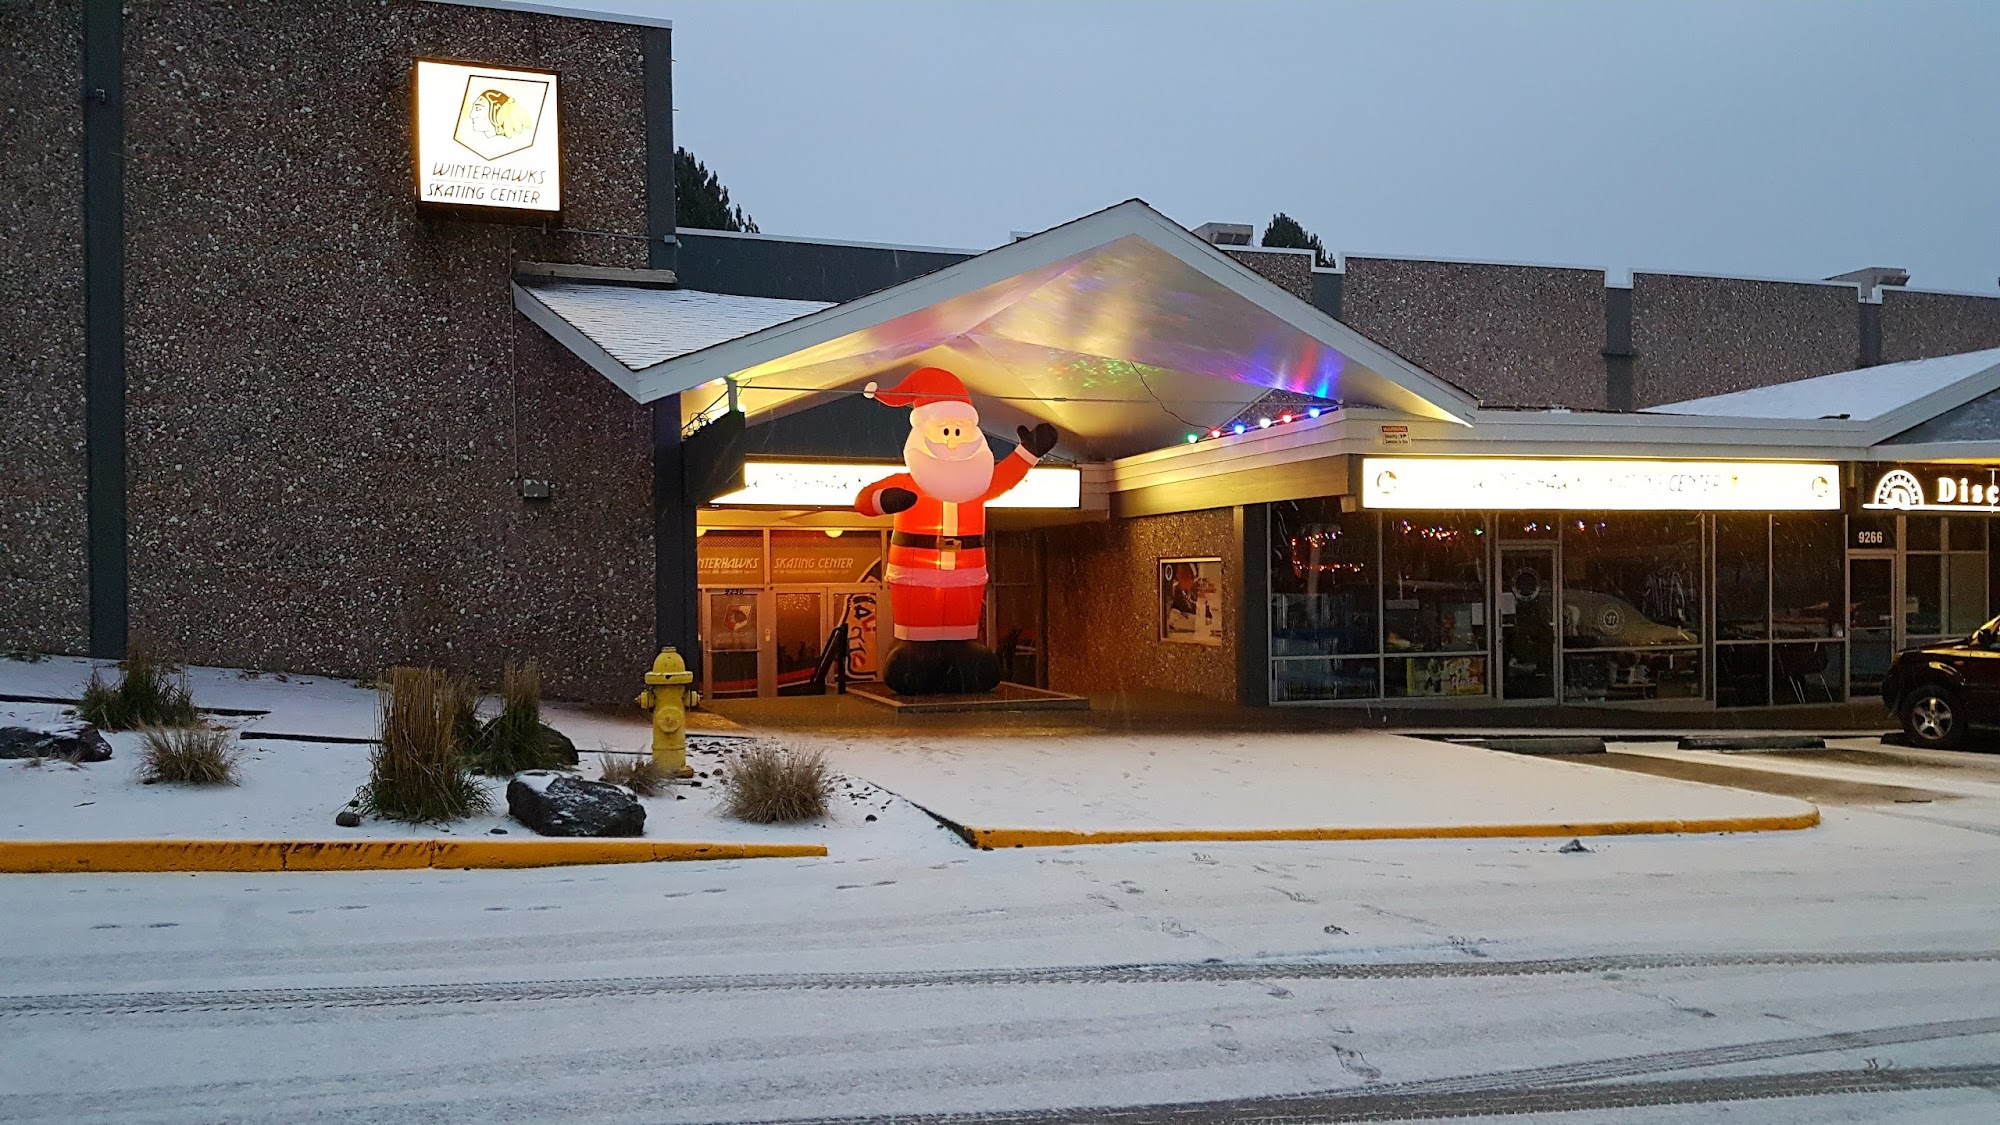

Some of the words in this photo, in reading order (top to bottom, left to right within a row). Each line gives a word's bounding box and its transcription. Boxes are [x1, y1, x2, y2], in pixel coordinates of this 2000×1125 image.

[432, 162, 546, 184] WINTERHAWKS
[427, 183, 485, 199] SKATING
[490, 188, 541, 203] CENTER
[1937, 476, 2000, 504] Disc
[1858, 531, 1883, 544] 9266
[774, 557, 816, 569] SKATING
[818, 557, 854, 569] CENTER
